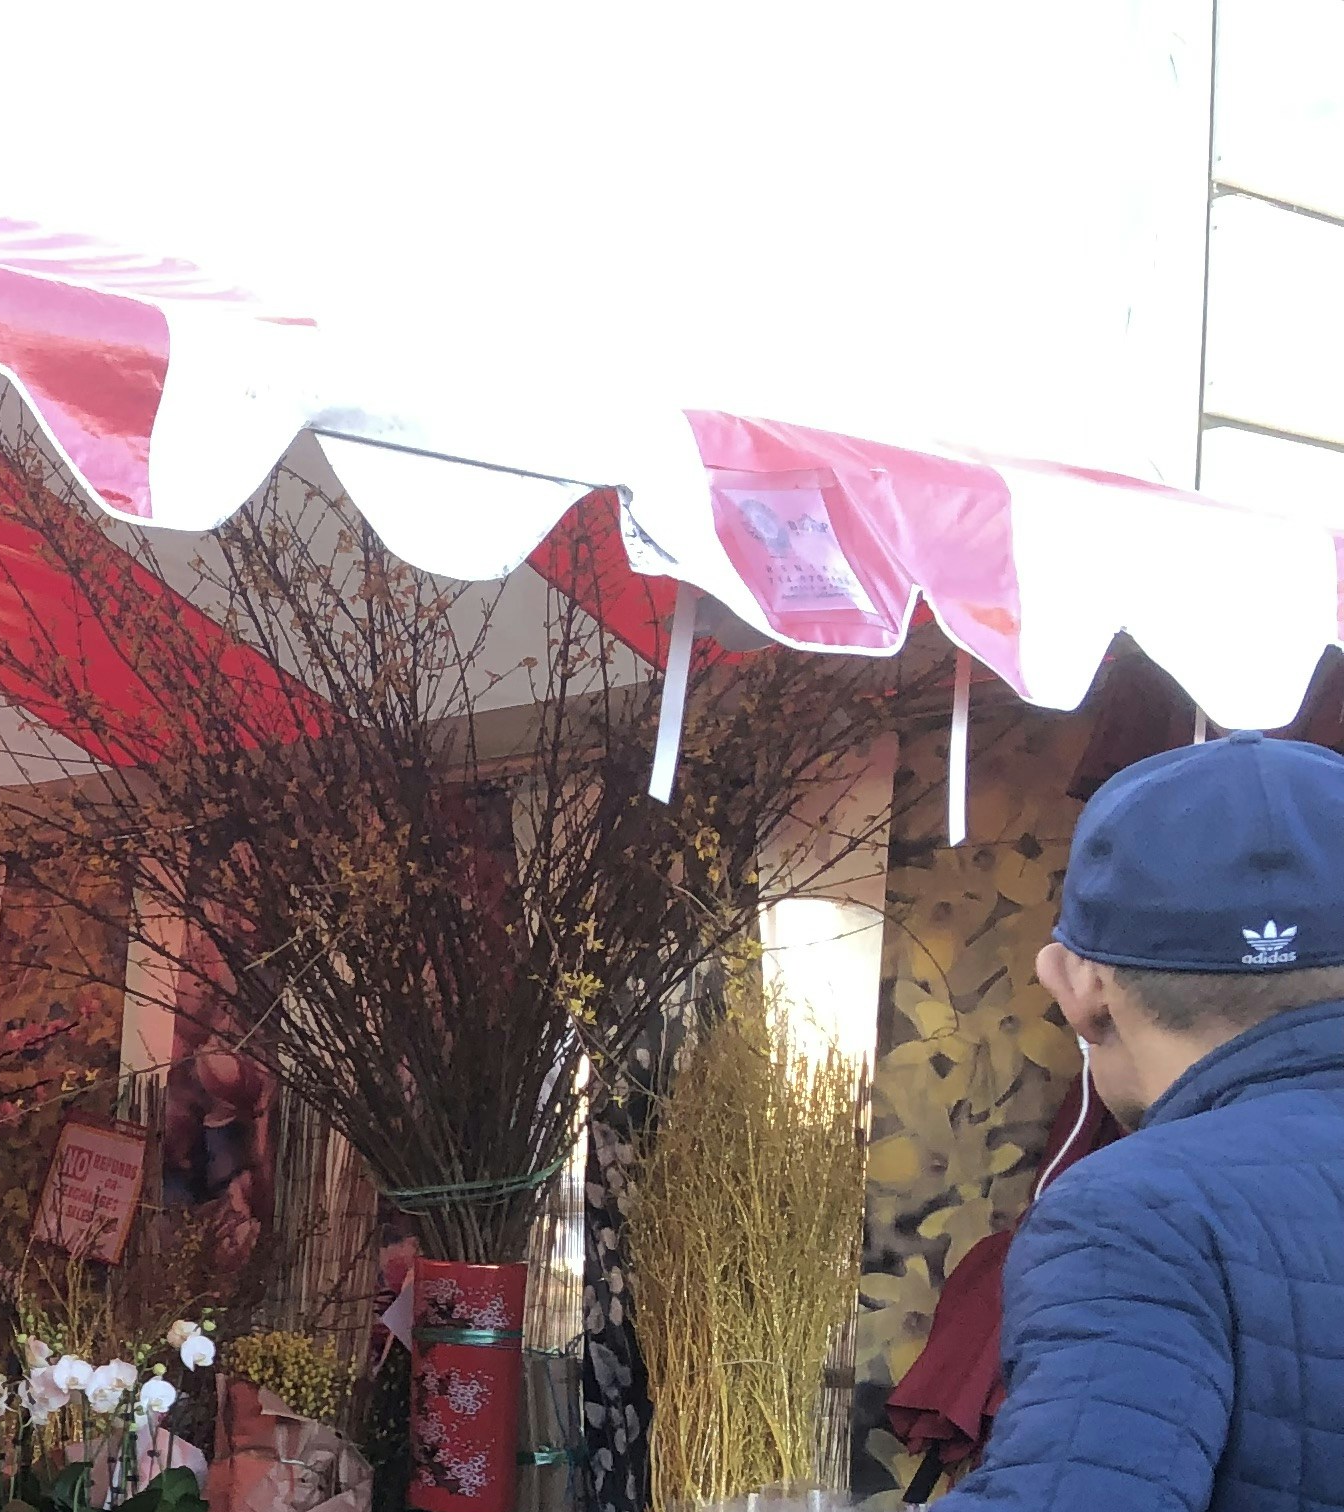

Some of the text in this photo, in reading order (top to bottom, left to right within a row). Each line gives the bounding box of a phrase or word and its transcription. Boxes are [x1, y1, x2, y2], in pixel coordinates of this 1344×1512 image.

[1241, 951, 1297, 965] adidas
[62, 1146, 138, 1181] NO REFUNDS
